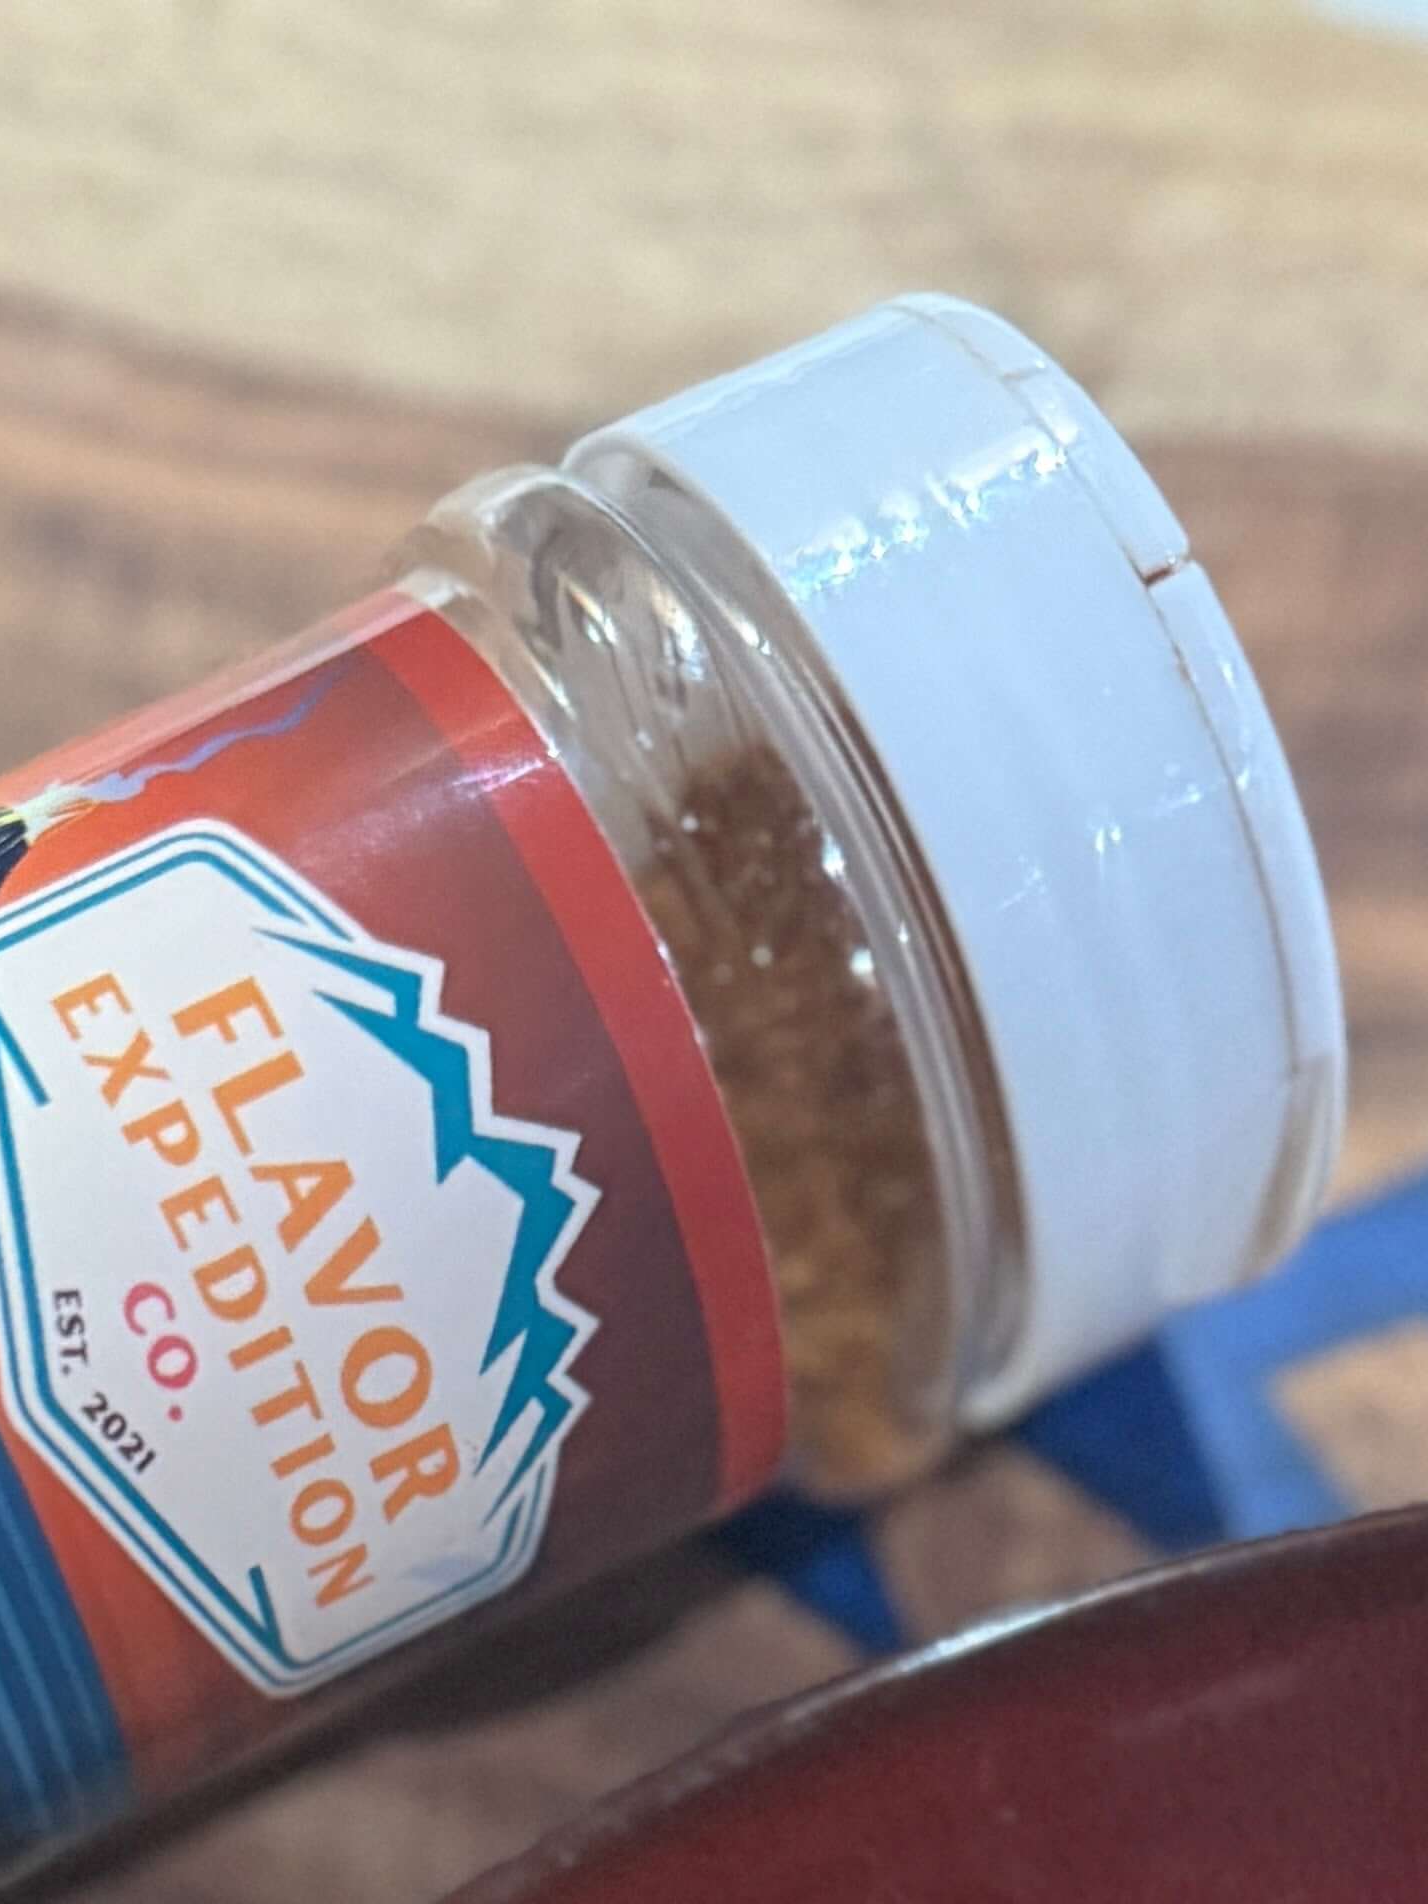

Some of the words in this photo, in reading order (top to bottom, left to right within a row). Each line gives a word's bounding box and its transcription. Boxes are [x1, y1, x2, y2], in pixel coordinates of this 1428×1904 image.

[51, 972, 379, 1609] EXPEDITION
[52, 1288, 89, 1376] EST.
[80, 1391, 157, 1475] 2021
[123, 1281, 199, 1423] CO.
[171, 976, 462, 1522] FLAVOR
